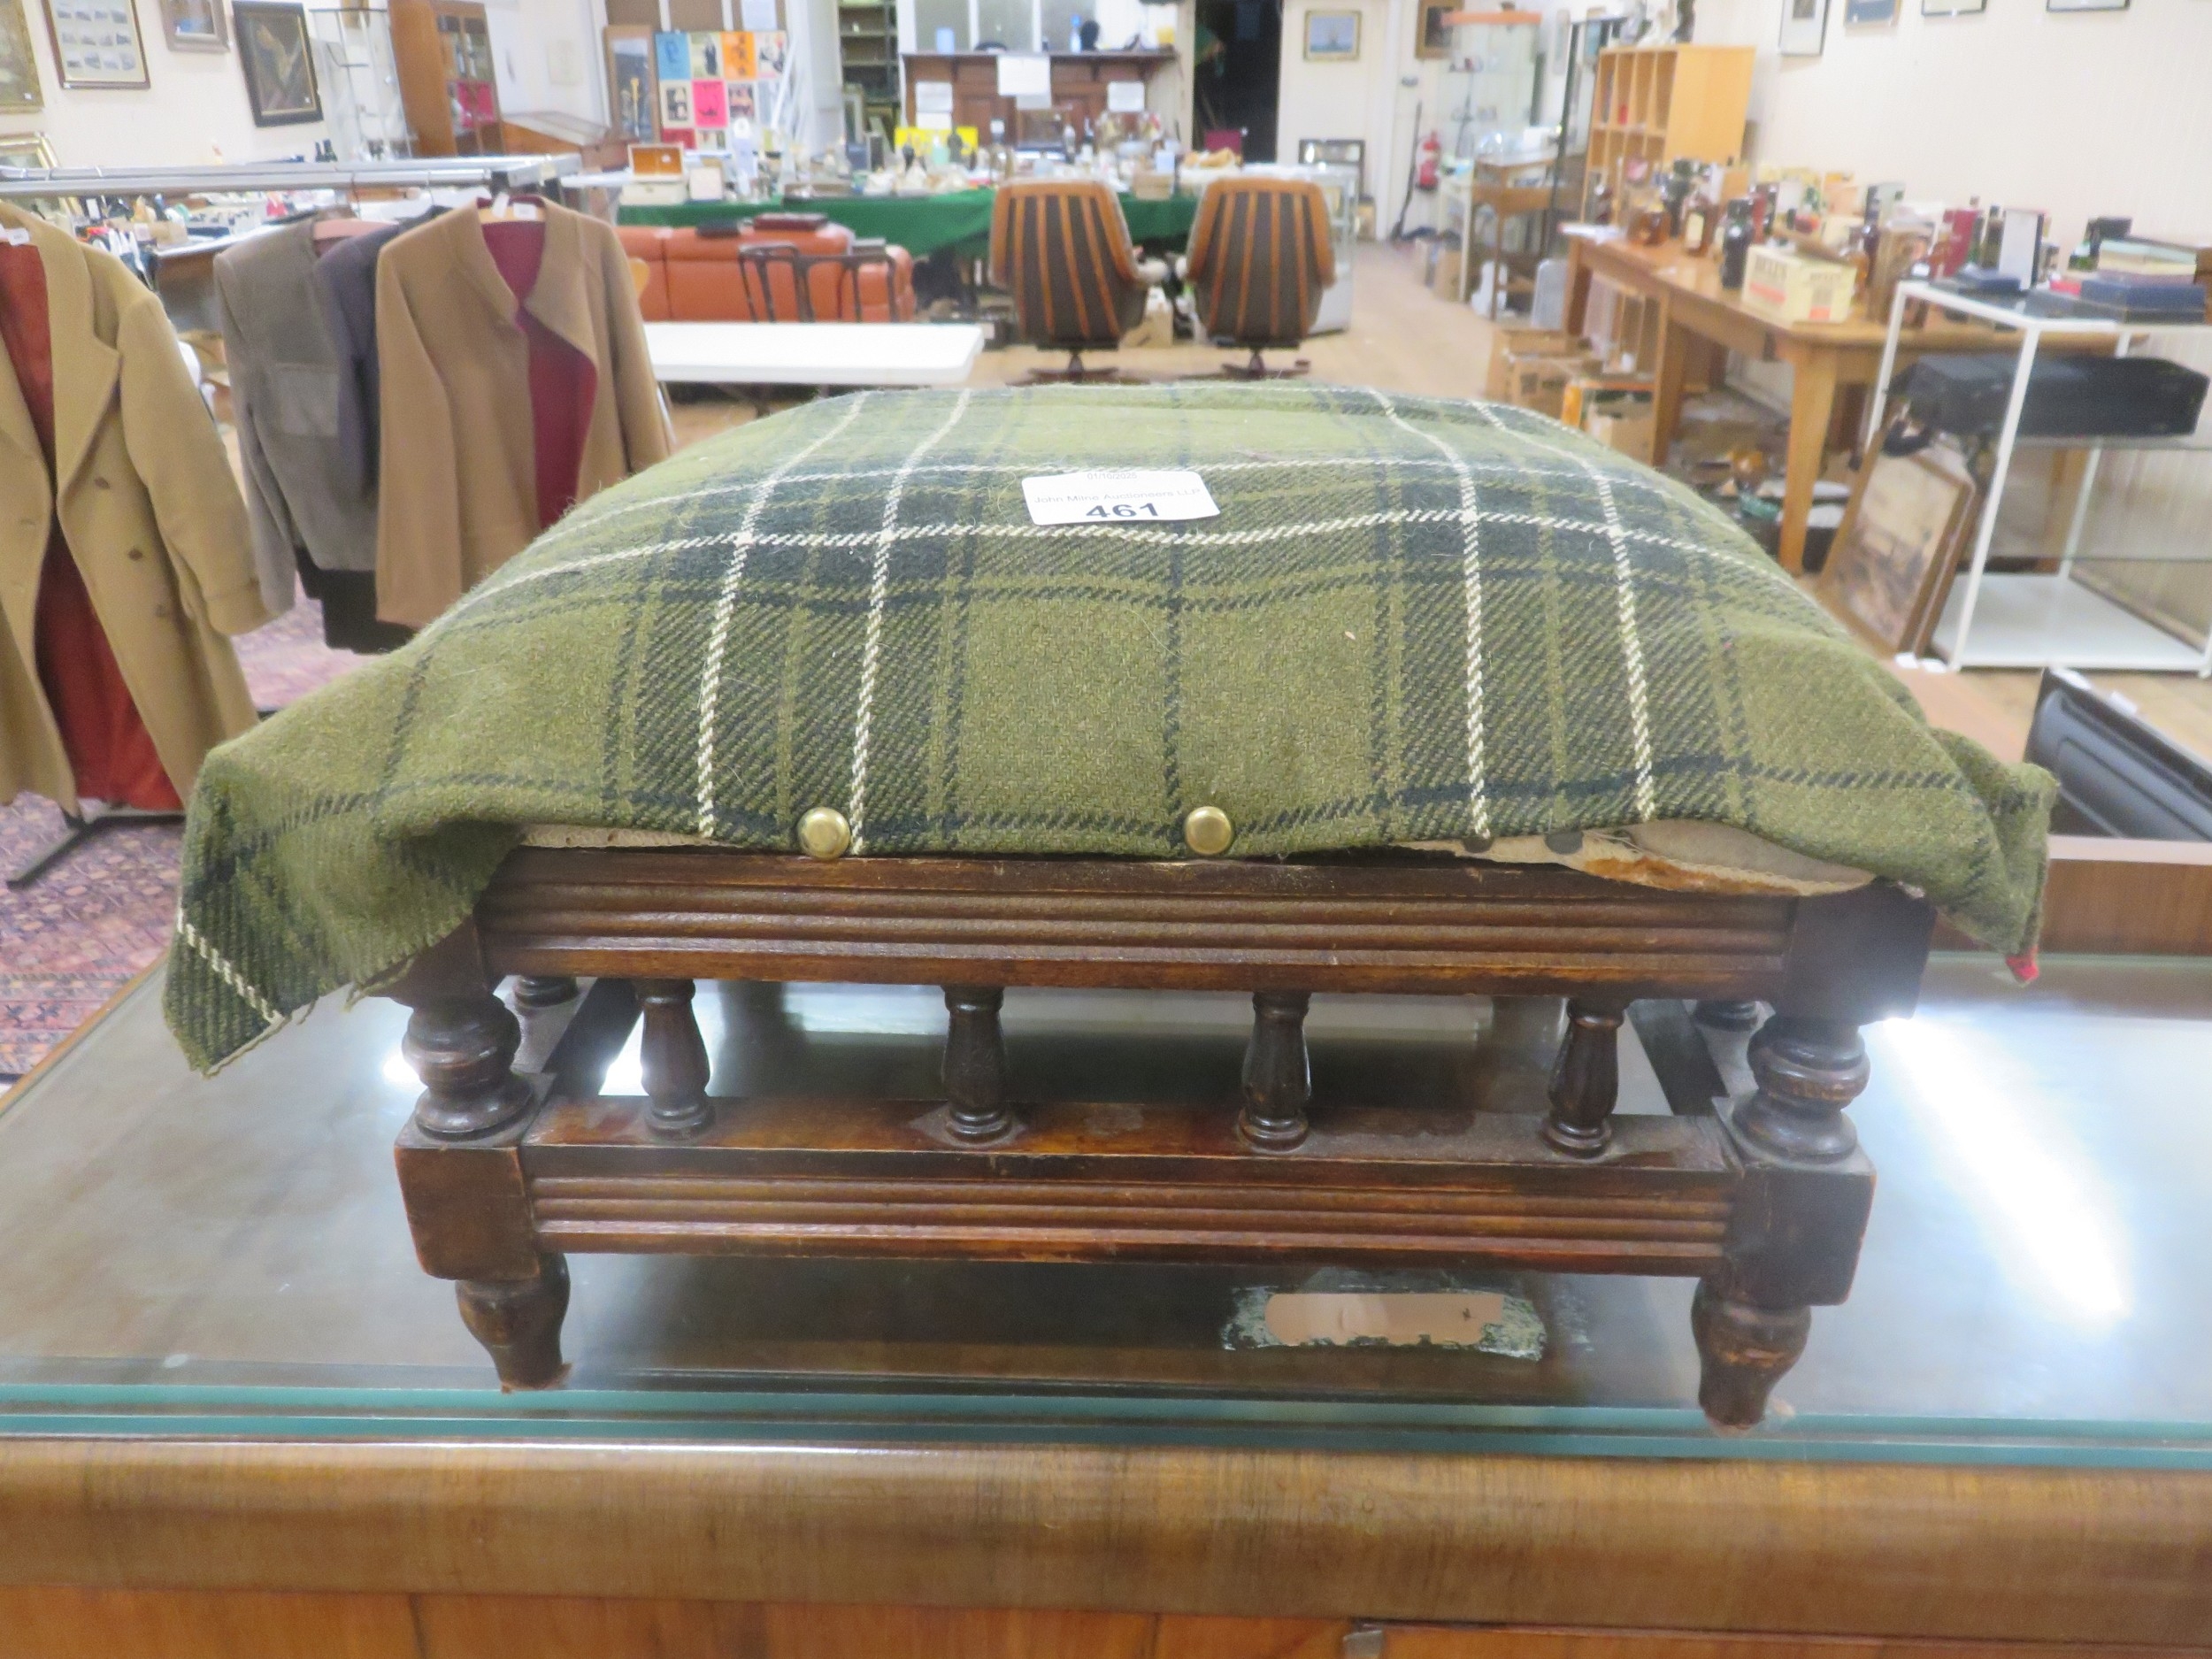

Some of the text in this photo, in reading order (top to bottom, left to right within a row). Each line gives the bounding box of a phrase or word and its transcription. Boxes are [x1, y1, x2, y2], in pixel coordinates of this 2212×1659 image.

[1034, 495, 1064, 503] John
[1103, 491, 1175, 500] Auctioneers
[1086, 503, 1159, 518] 461
